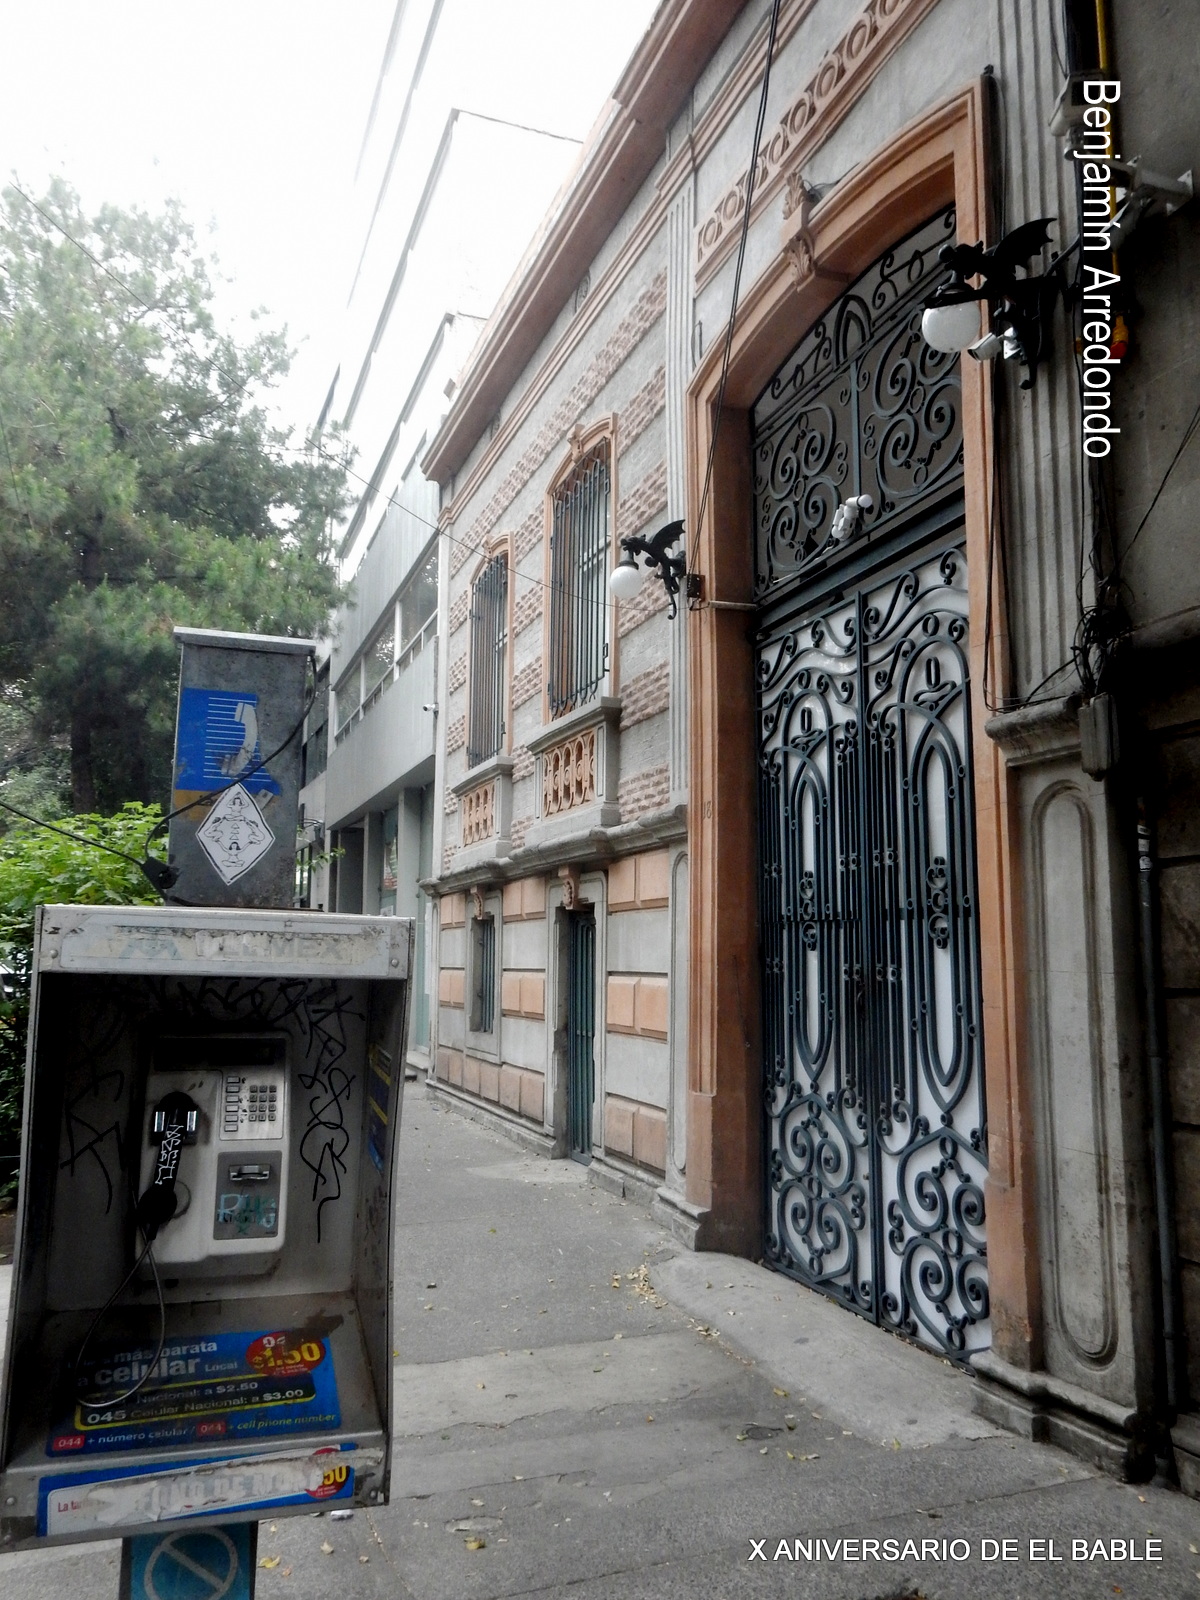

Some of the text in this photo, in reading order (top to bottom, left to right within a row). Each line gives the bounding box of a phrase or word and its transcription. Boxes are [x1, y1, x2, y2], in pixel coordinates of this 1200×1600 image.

[196, 931, 344, 961] ELMEX
[94, 1357, 201, 1386] celular
[204, 1361, 238, 1372] Local
[216, 1381, 258, 1394] $2.50
[87, 1410, 126, 1424] 045
[262, 1389, 304, 1402] $3.00
[58, 1437, 82, 1447] 044
[98, 1431, 146, 1444] número
[148, 1428, 188, 1439] celular
[237, 1420, 256, 1430] cell
[58, 1501, 69, 1513] La
